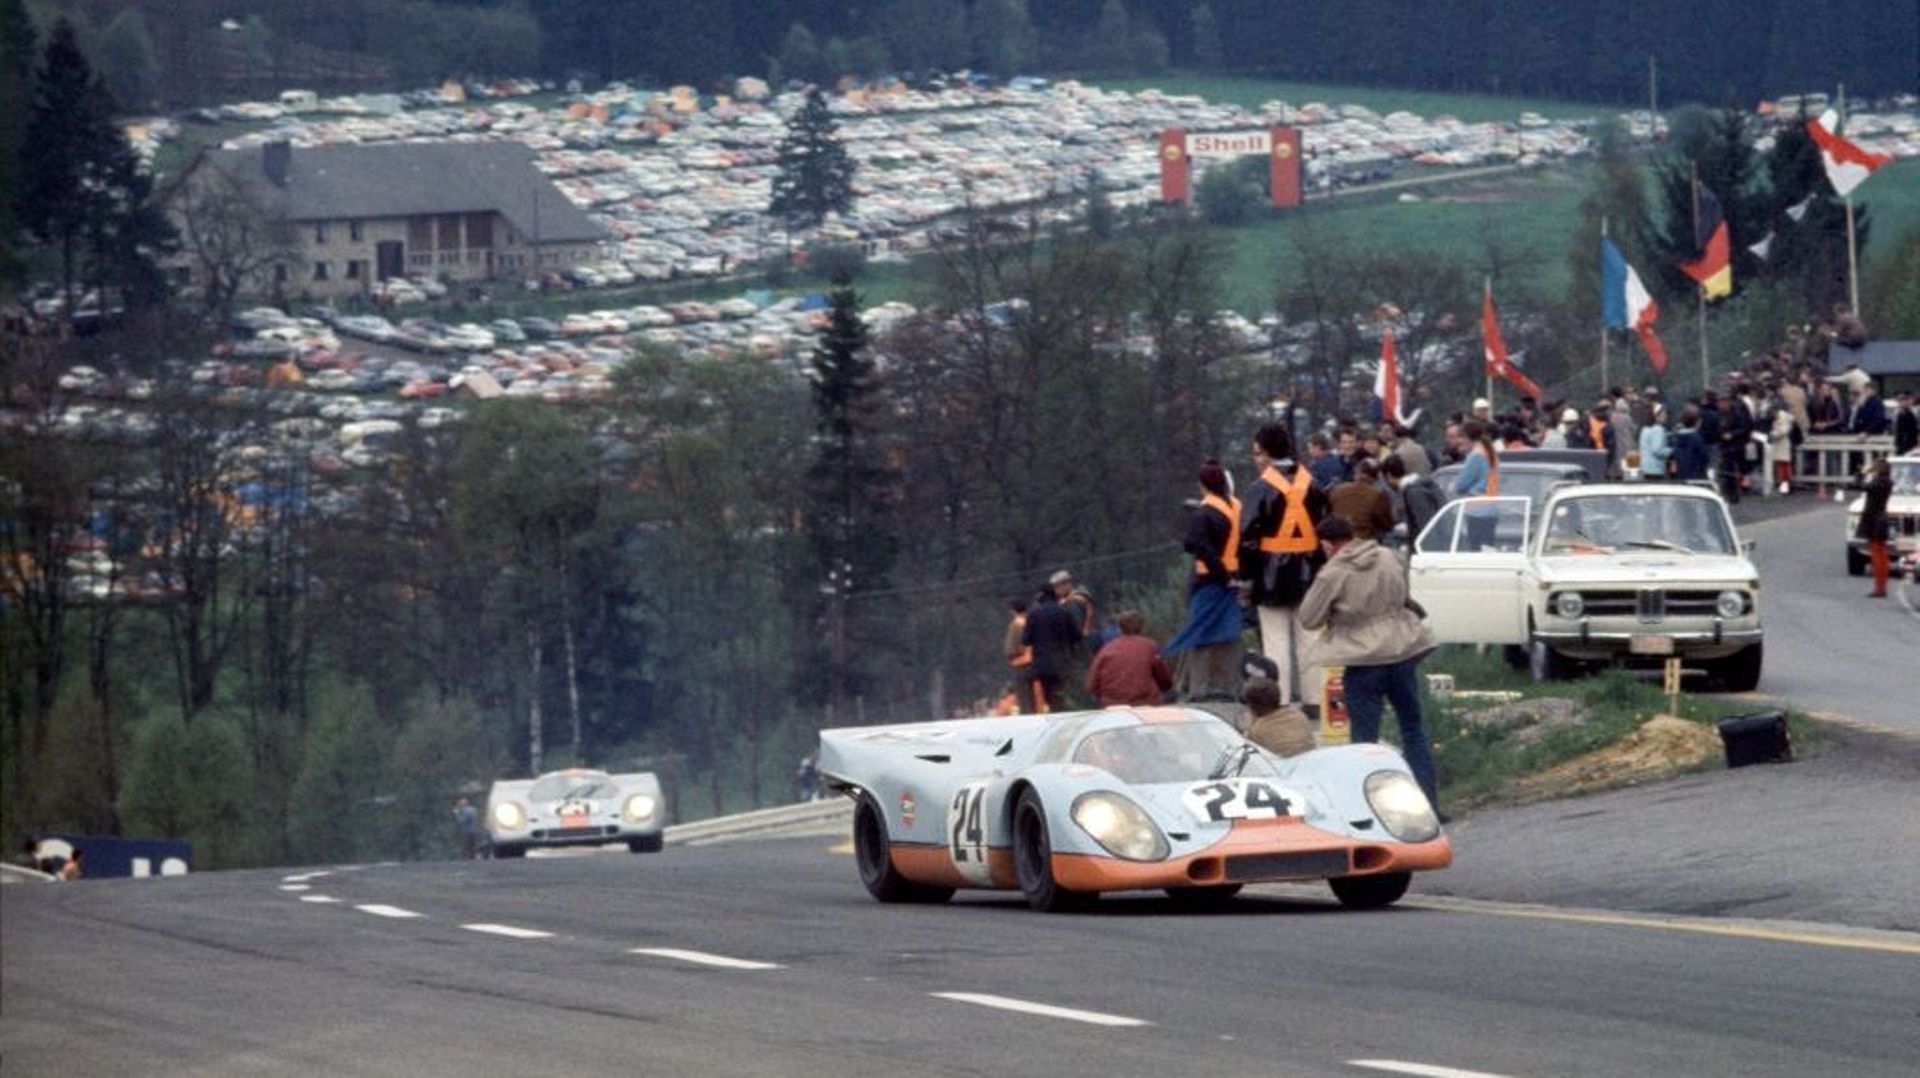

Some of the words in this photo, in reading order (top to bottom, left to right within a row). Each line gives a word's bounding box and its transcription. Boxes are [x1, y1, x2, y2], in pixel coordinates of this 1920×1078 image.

[1195, 136, 1263, 151] Shell
[1192, 782, 1292, 821] 24
[953, 787, 985, 863] 24
